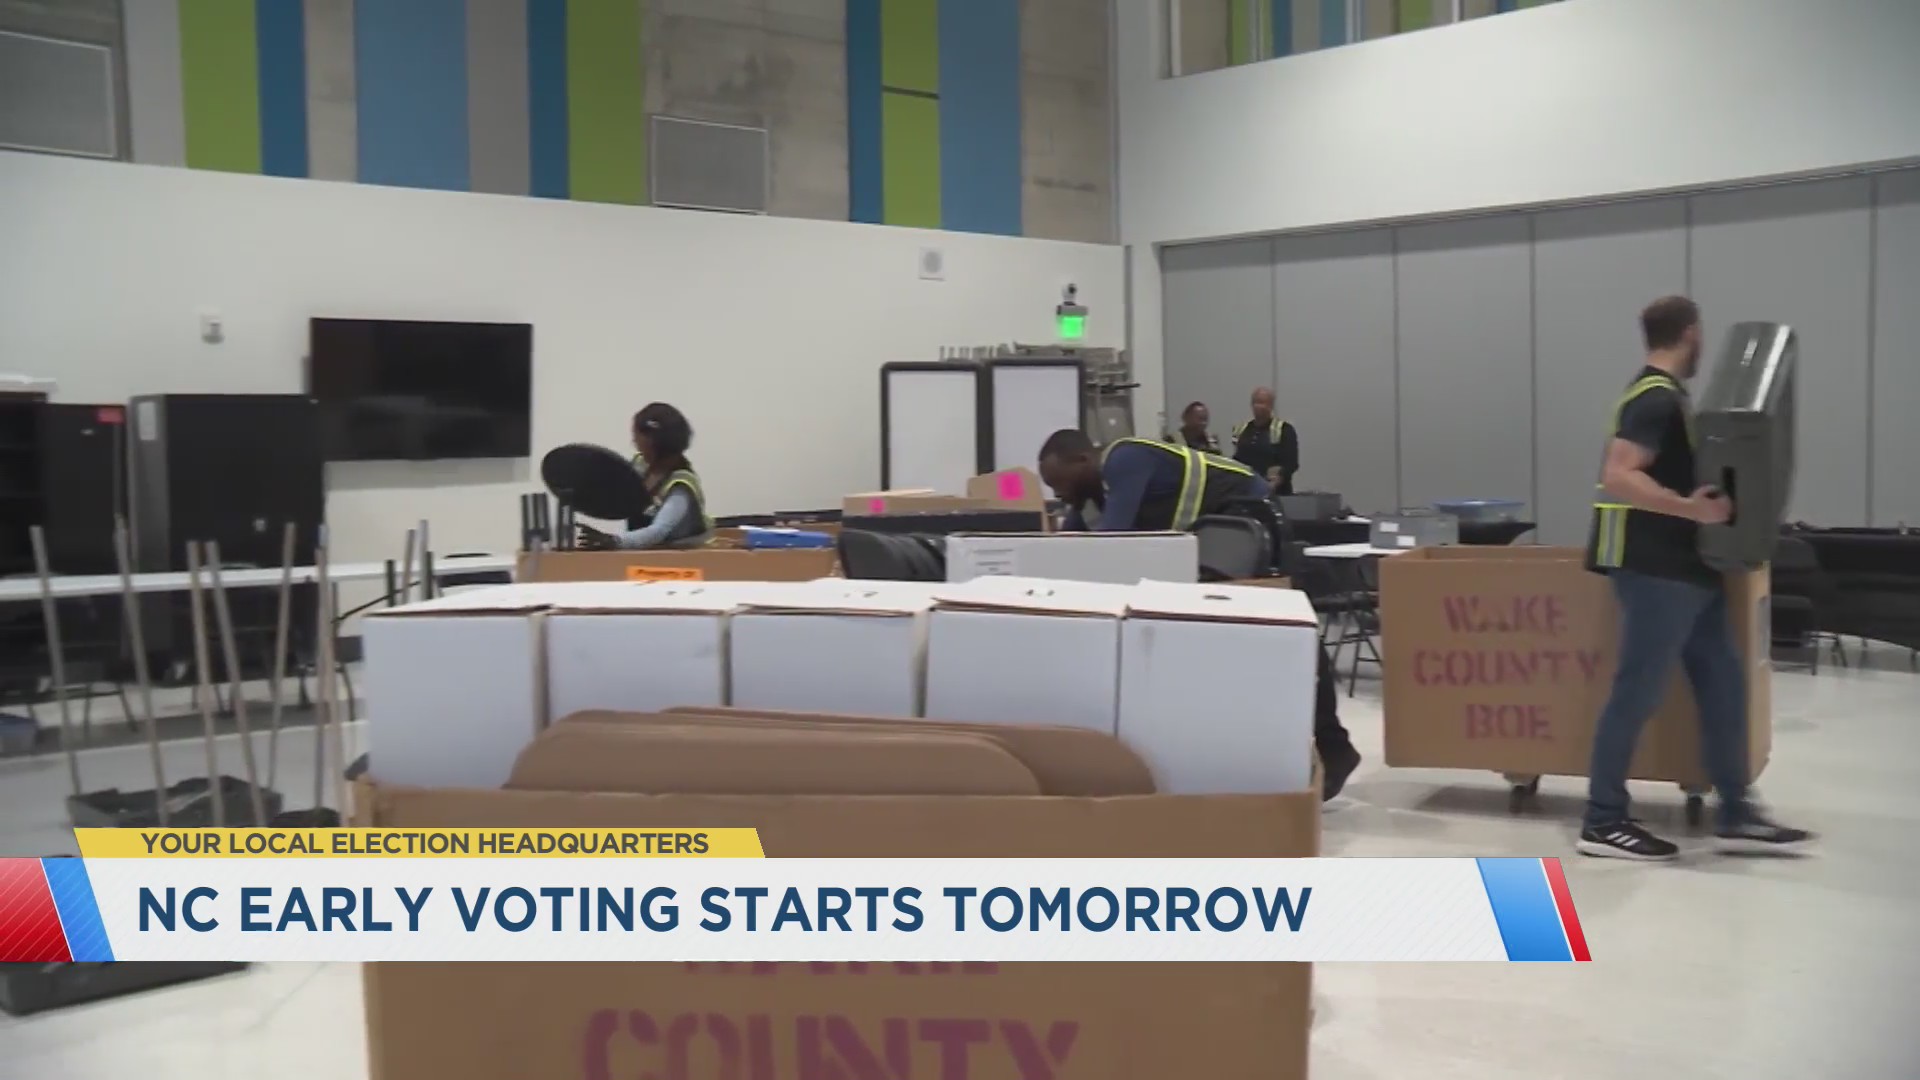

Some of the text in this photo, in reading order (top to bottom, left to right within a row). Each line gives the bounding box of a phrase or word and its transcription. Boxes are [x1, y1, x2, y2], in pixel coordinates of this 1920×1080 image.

[1444, 596, 1568, 634] WAKE
[1413, 649, 1602, 686] COUNTY
[1465, 704, 1554, 740] BOE
[583, 1009, 1080, 1080] COUNTY
